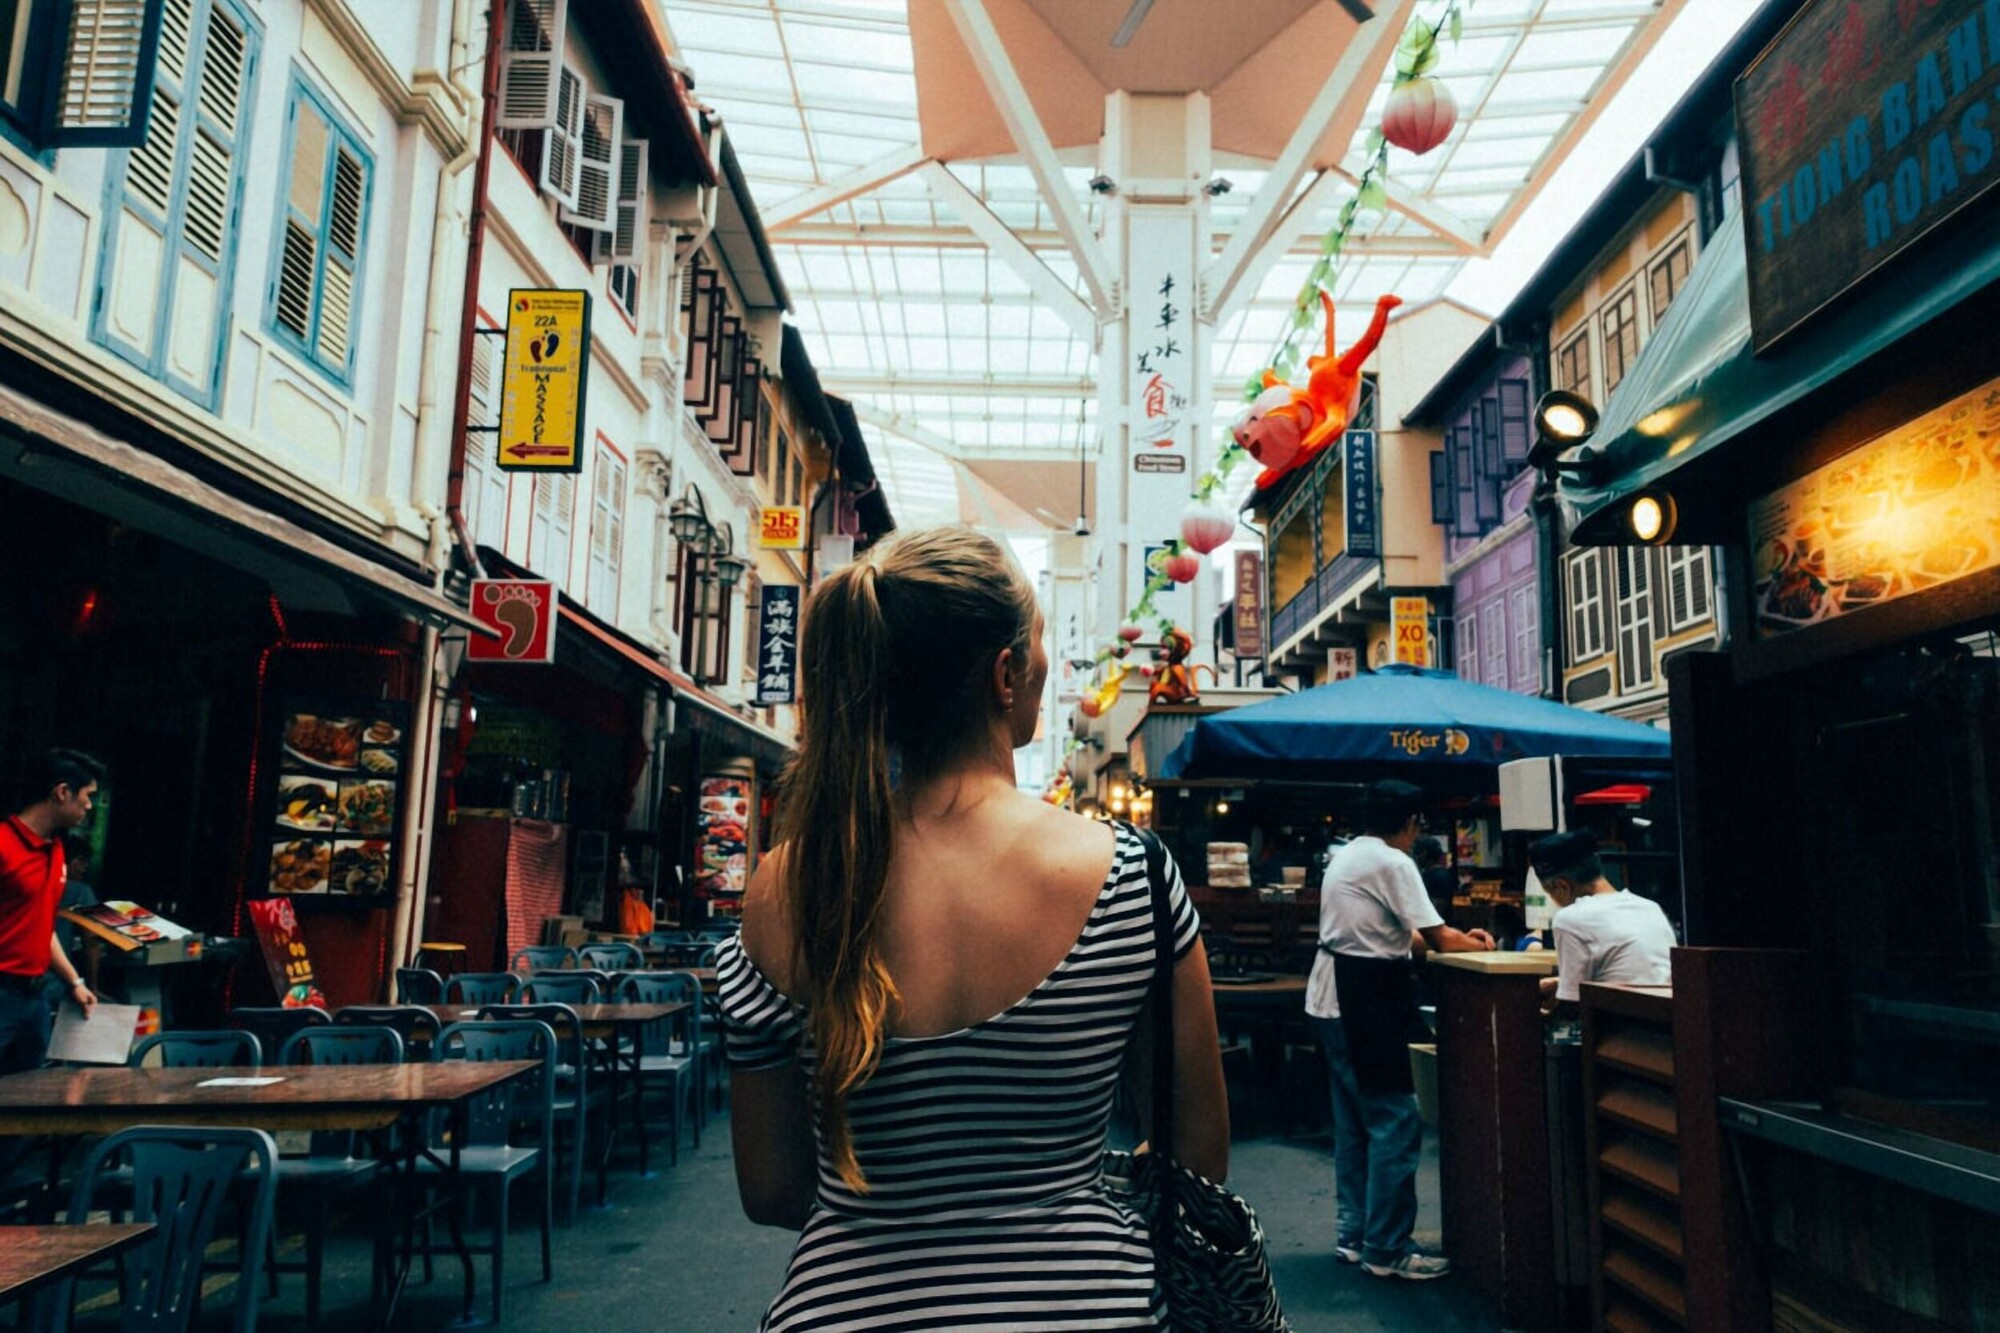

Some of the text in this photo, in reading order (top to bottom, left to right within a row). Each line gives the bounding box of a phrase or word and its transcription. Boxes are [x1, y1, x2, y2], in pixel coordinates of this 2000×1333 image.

[1863, 84, 2000, 249] ROAS
[1756, 113, 1872, 254] TIONG
[534, 315, 557, 327] 22A
[533, 374, 551, 444] MASSAGE
[762, 511, 799, 528] 515
[1398, 624, 1424, 642] XO
[1390, 729, 1441, 756] Tiger
